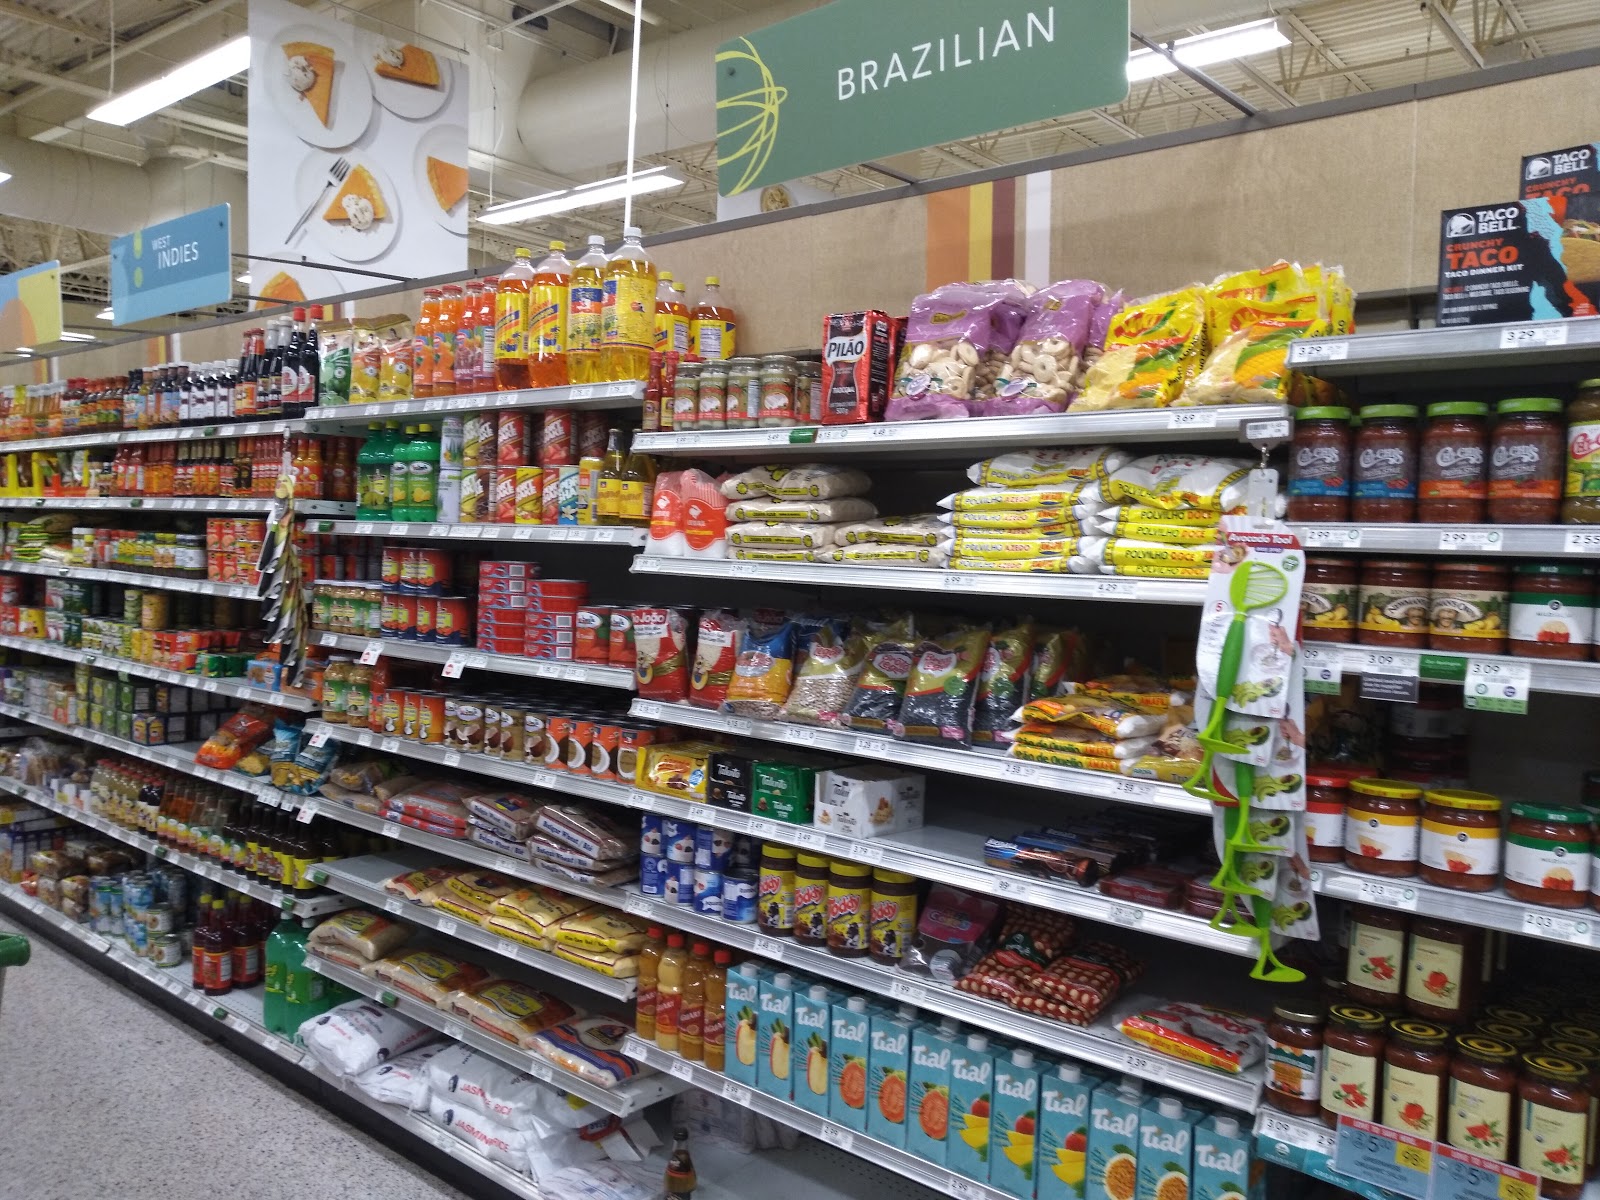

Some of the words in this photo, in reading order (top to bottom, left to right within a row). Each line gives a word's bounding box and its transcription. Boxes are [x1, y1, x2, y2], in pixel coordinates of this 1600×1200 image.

[838, 6, 1055, 101] BRAZILIAN
[1552, 149, 1591, 165] TACO
[1553, 163, 1591, 176] BELL
[1476, 207, 1519, 222] TACO
[1478, 220, 1518, 234] BELL
[151, 235, 171, 250] WEST
[1446, 238, 1504, 252] CRUNCHY
[158, 241, 199, 270] INDIES
[1446, 246, 1518, 269] TACO
[1444, 270, 1469, 278] TACO
[1469, 265, 1506, 276] DINNER
[1506, 263, 1525, 272] KIT
[826, 339, 864, 358] PILÃO
[965, 496, 1003, 506] POLVILHO
[963, 513, 1001, 522] POLVILHO
[1141, 511, 1185, 521] POLVILHO
[1187, 511, 1213, 520] DOCE
[966, 527, 1005, 535] POLVILHO
[1136, 527, 1179, 538] POLVILHO
[1181, 529, 1206, 539] DOCE
[1228, 533, 1271, 544] Avocado
[1272, 534, 1293, 546] Tool
[965, 543, 1004, 553] POLVILHO
[1125, 550, 1168, 560] POLVILHO
[1171, 552, 1196, 562] DOCE
[961, 560, 997, 568] POLVILHO
[1136, 566, 1179, 576] POLVILHO
[1181, 567, 1204, 576] DOCE
[760, 993, 790, 1015] Tial
[795, 1006, 827, 1028] Tial
[833, 1019, 867, 1043] Tial
[871, 1031, 907, 1054] Tial
[912, 1045, 949, 1070] Tial
[953, 1058, 991, 1086] Tial
[995, 1074, 1036, 1100] Tial
[1042, 1090, 1087, 1117] Tial
[1092, 1107, 1138, 1137] Tial
[1141, 1125, 1189, 1155] Tial
[1195, 1144, 1247, 1174] Tial
